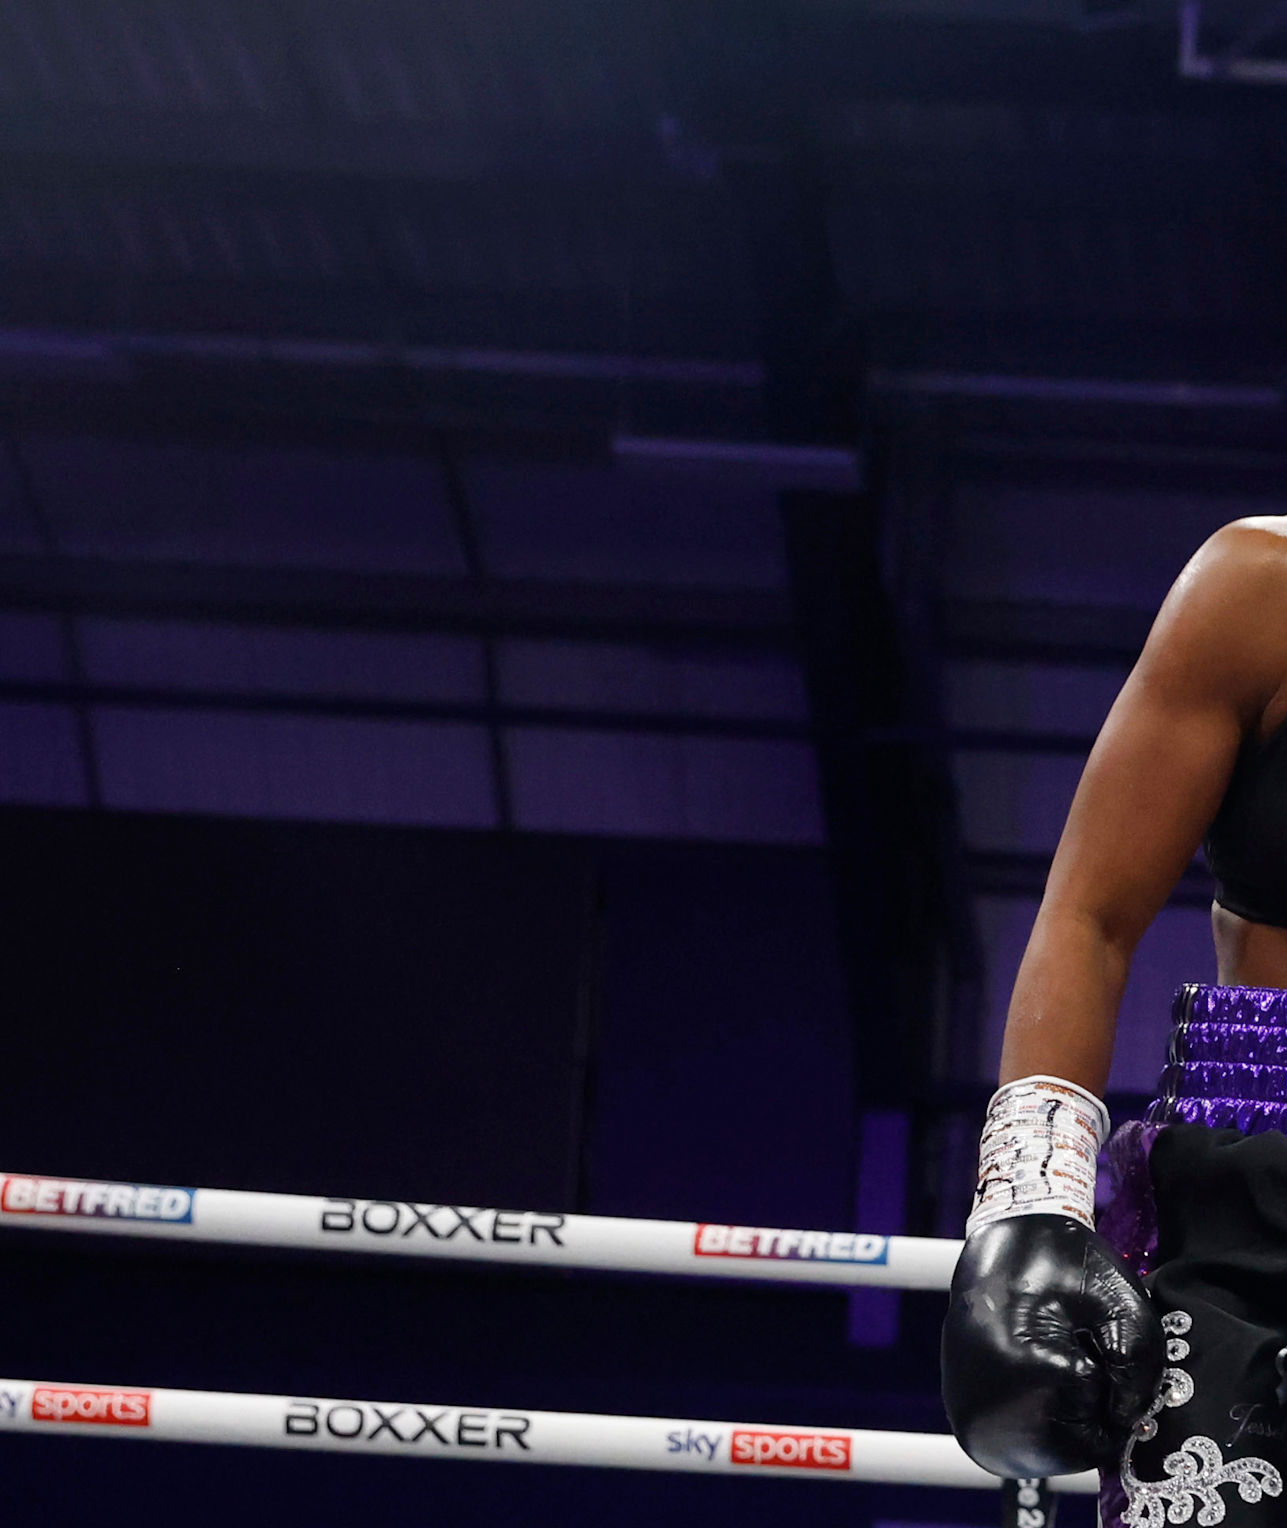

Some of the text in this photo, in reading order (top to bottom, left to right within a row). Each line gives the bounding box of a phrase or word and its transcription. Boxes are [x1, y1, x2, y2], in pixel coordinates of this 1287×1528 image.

[7, 1178, 191, 1221] BETFRED
[321, 1198, 565, 1247] BOXXER
[697, 1224, 887, 1263] BETFRED
[34, 1389, 147, 1421] sports
[285, 1402, 532, 1451] BOXXER
[667, 1428, 847, 1468] sky sports
